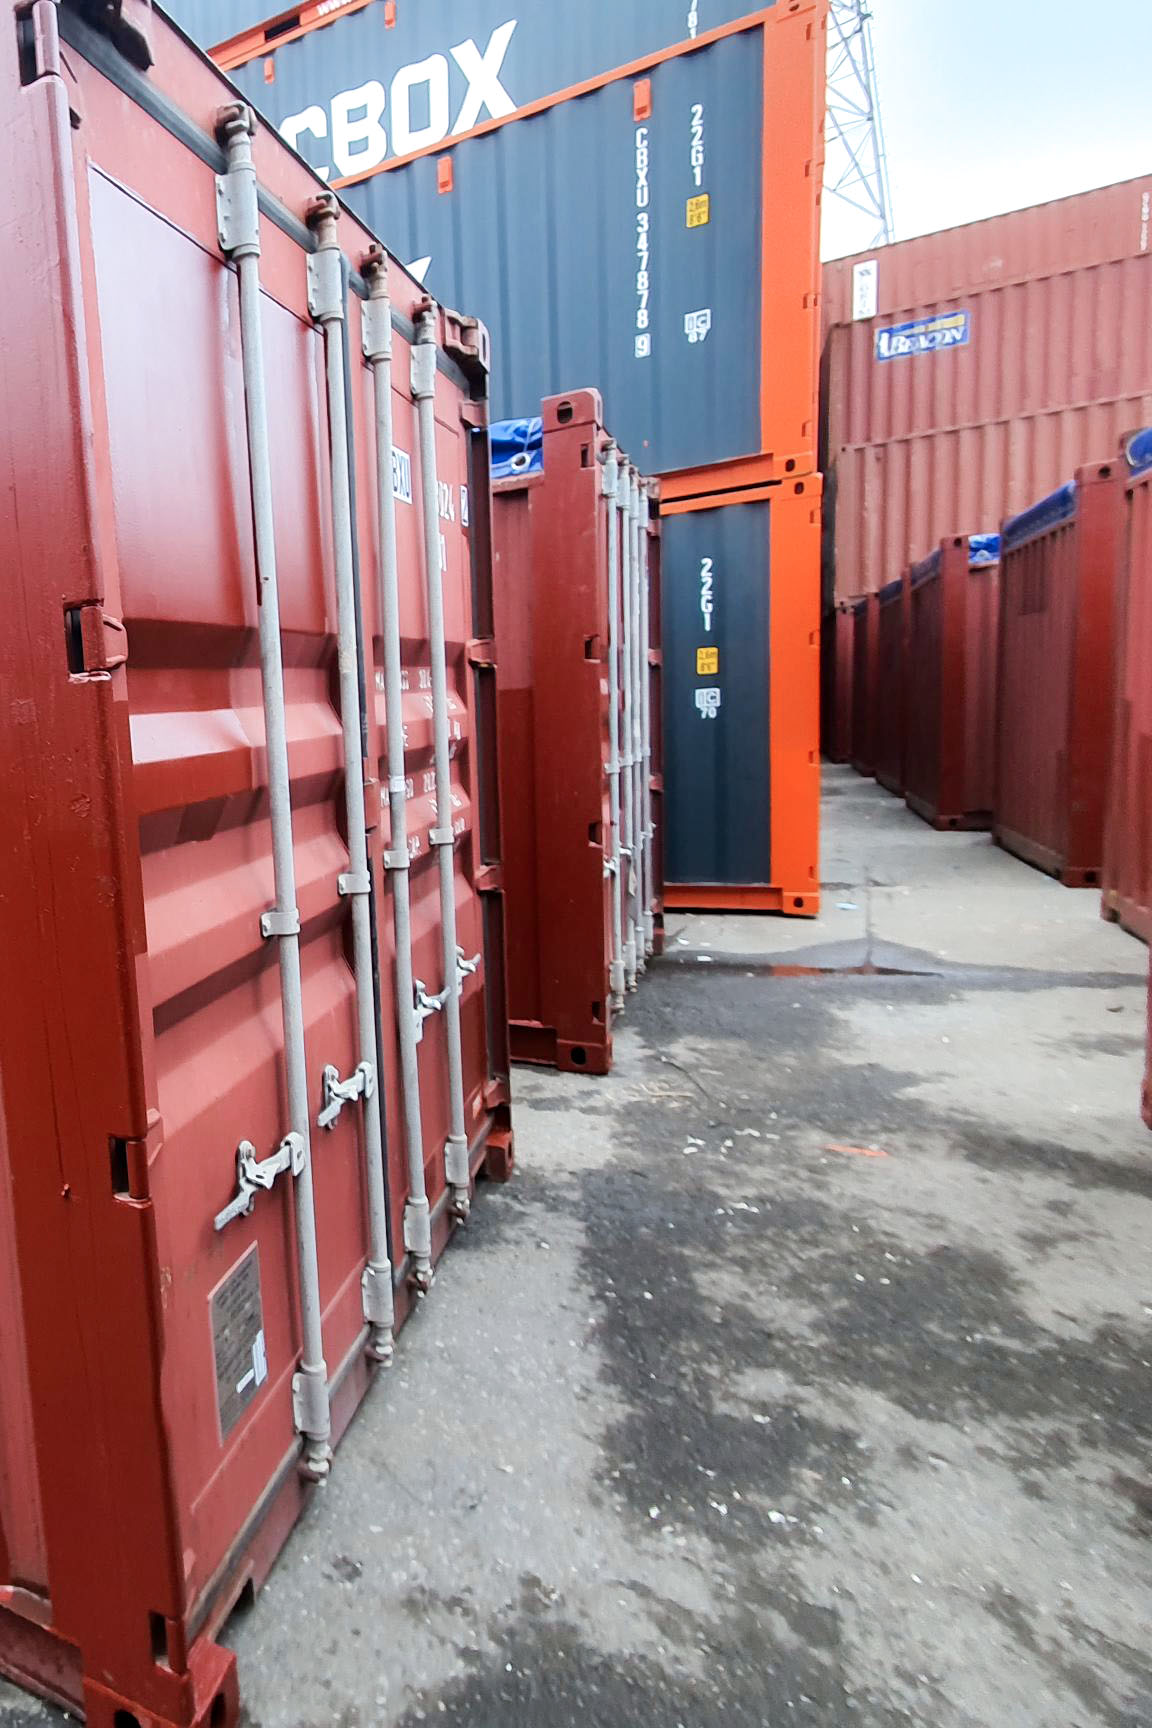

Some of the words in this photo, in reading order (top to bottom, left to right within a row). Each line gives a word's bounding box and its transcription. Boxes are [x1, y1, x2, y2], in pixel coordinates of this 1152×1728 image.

[279, 19, 517, 181] CBOX
[636, 127, 648, 207] CBXU
[691, 104, 703, 186] 22G1
[636, 212, 648, 329] 347878
[700, 557, 713, 631] 22G1
